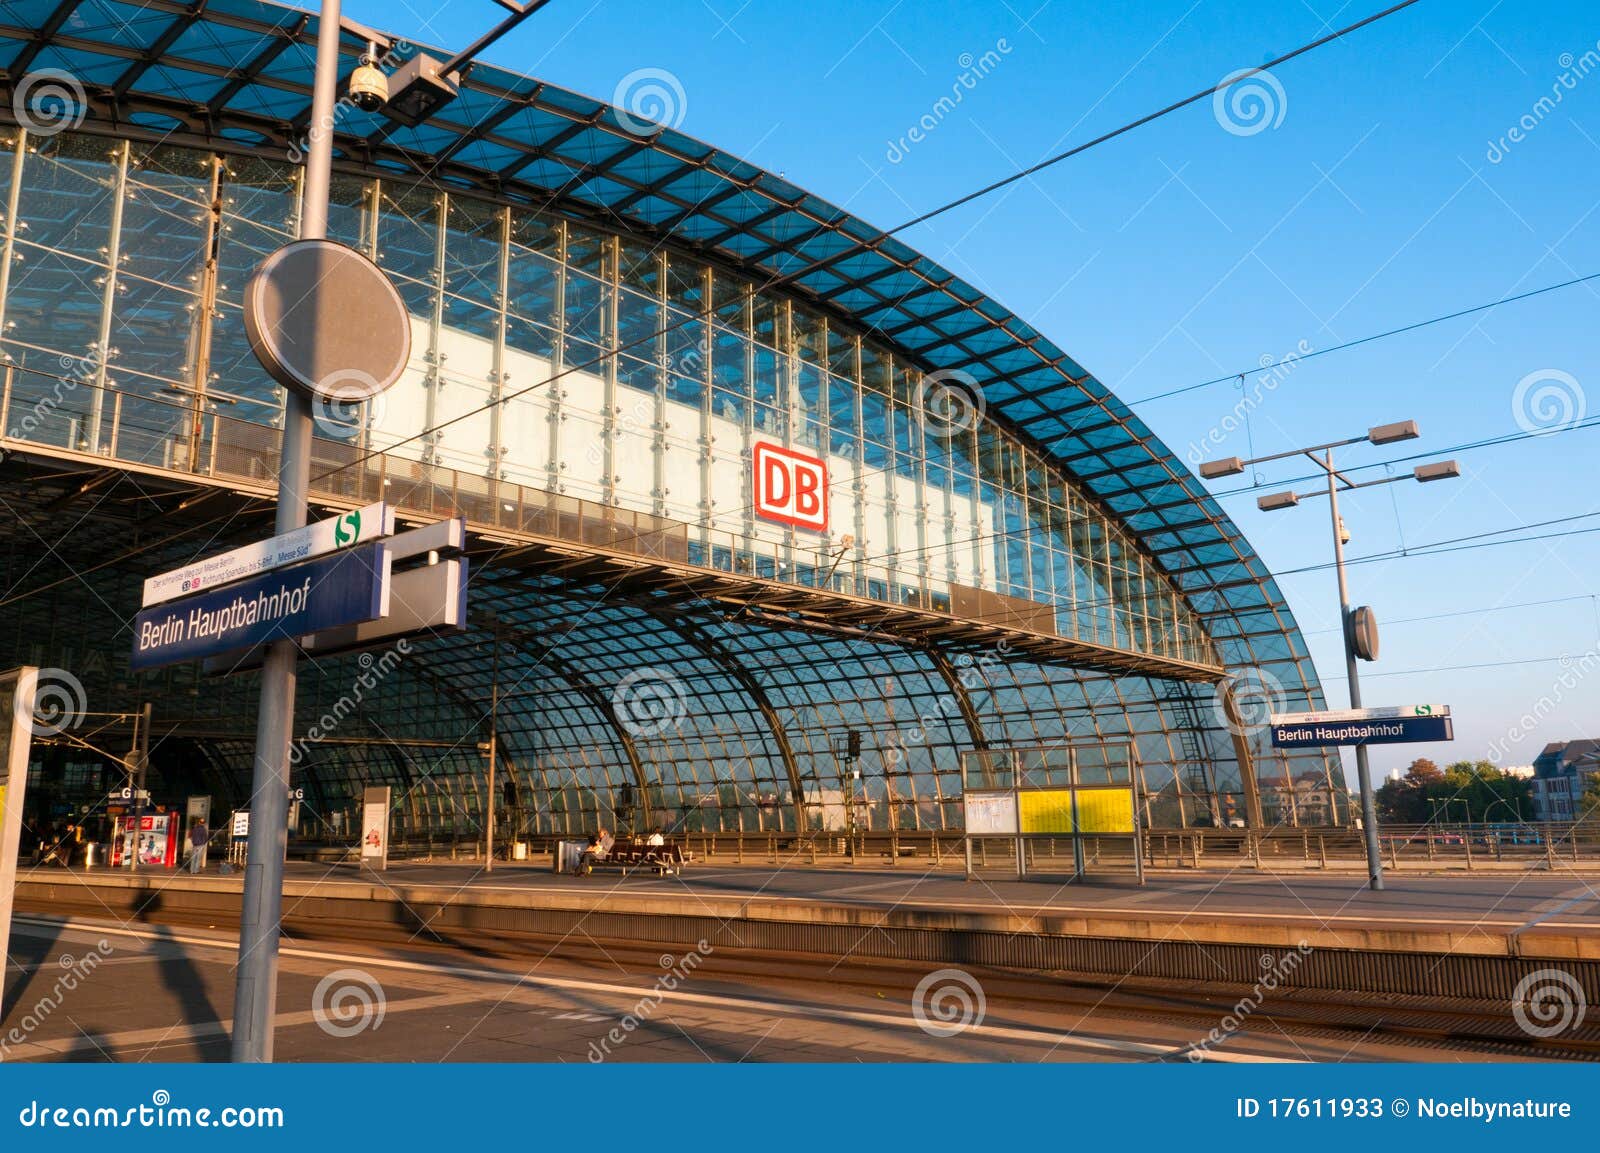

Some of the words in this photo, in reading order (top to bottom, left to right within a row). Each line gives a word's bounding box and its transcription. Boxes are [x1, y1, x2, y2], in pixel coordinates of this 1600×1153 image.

[763, 453, 821, 518] DB
[139, 616, 183, 650] Berlin
[187, 576, 311, 640] Hauptbahnhof
[1277, 727, 1313, 742] Berlin
[1315, 722, 1405, 742] Hauptbahnhof
[121, 787, 132, 799] G
[295, 788, 304, 800] G
